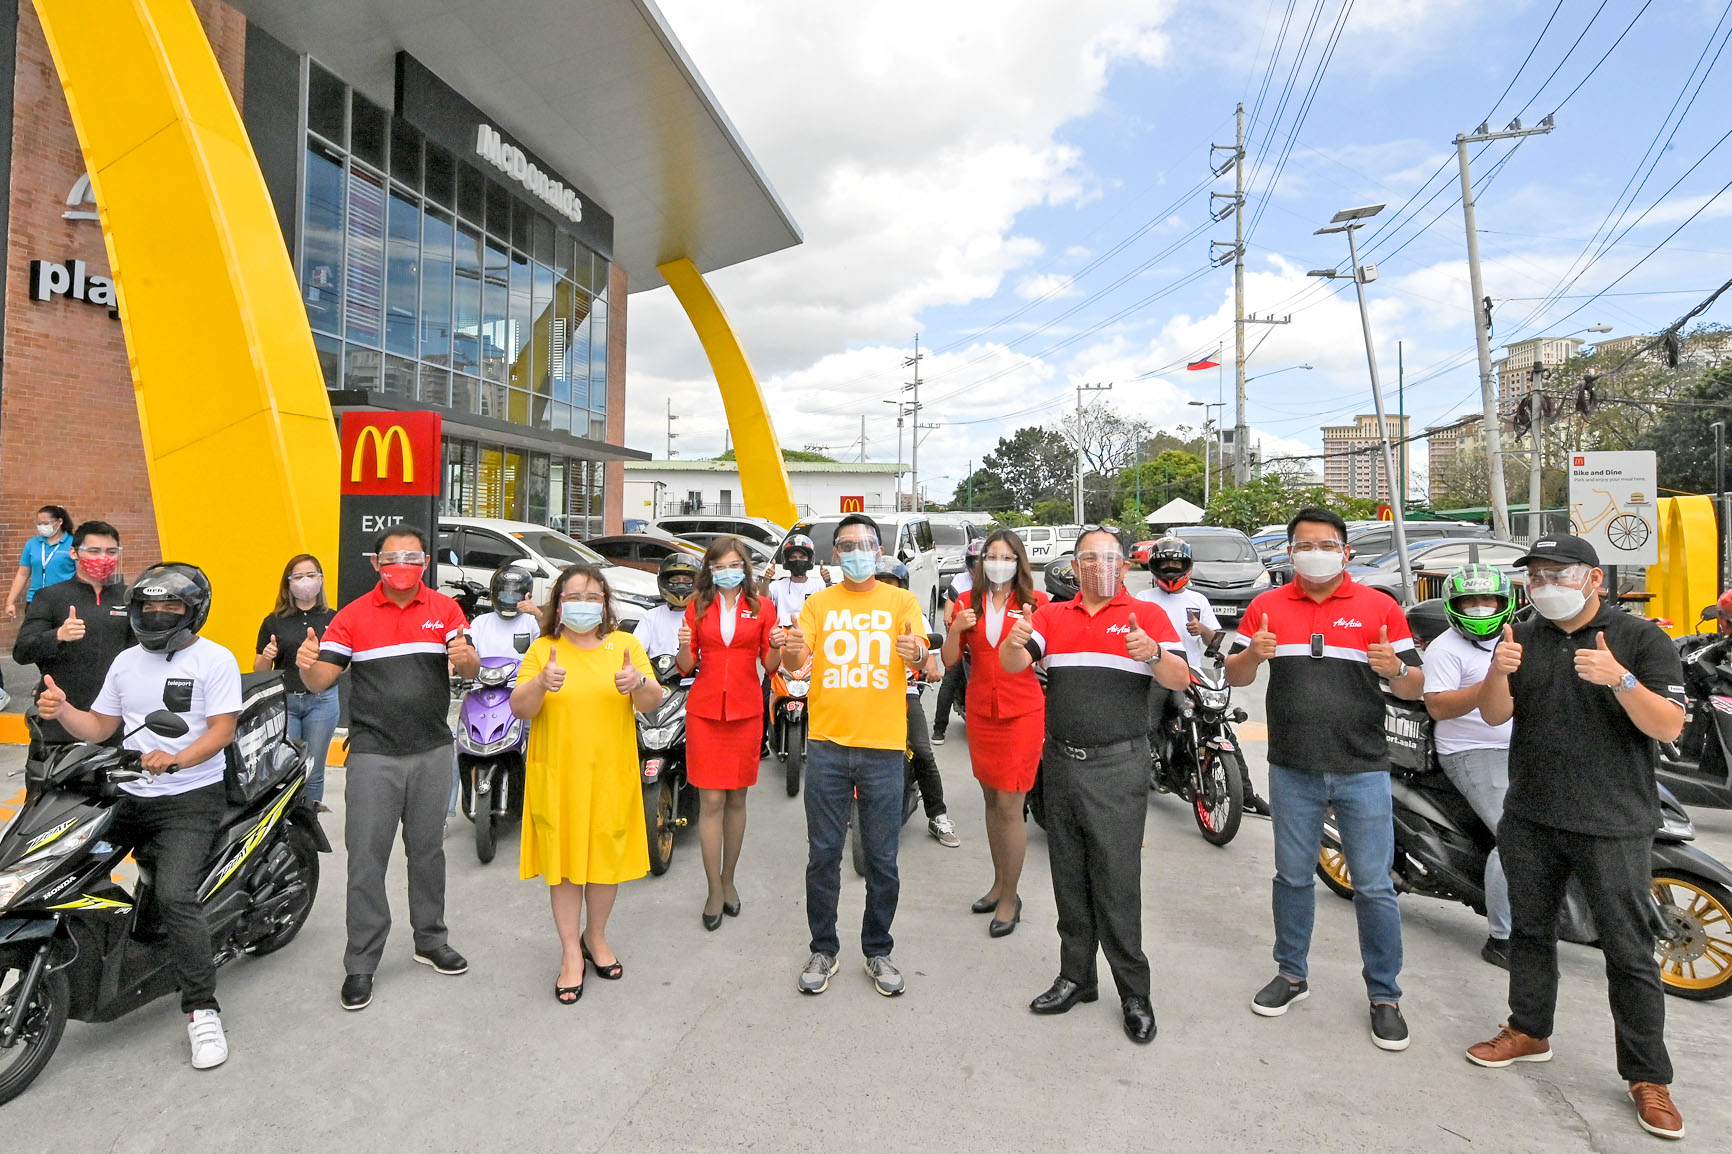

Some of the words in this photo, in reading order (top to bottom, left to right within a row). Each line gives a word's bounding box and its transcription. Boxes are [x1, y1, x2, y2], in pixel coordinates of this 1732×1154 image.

[476, 124, 582, 222] McDonald's
[34, 259, 120, 318] pla
[362, 515, 404, 532] EXIT
[1032, 544, 1052, 556] PTV
[823, 609, 893, 632] McD
[1106, 624, 1131, 635] AirAsi
[823, 630, 892, 666] on
[822, 663, 890, 690] ald's
[1385, 735, 1417, 749] ort.asia
[43, 876, 77, 900] HONDA
